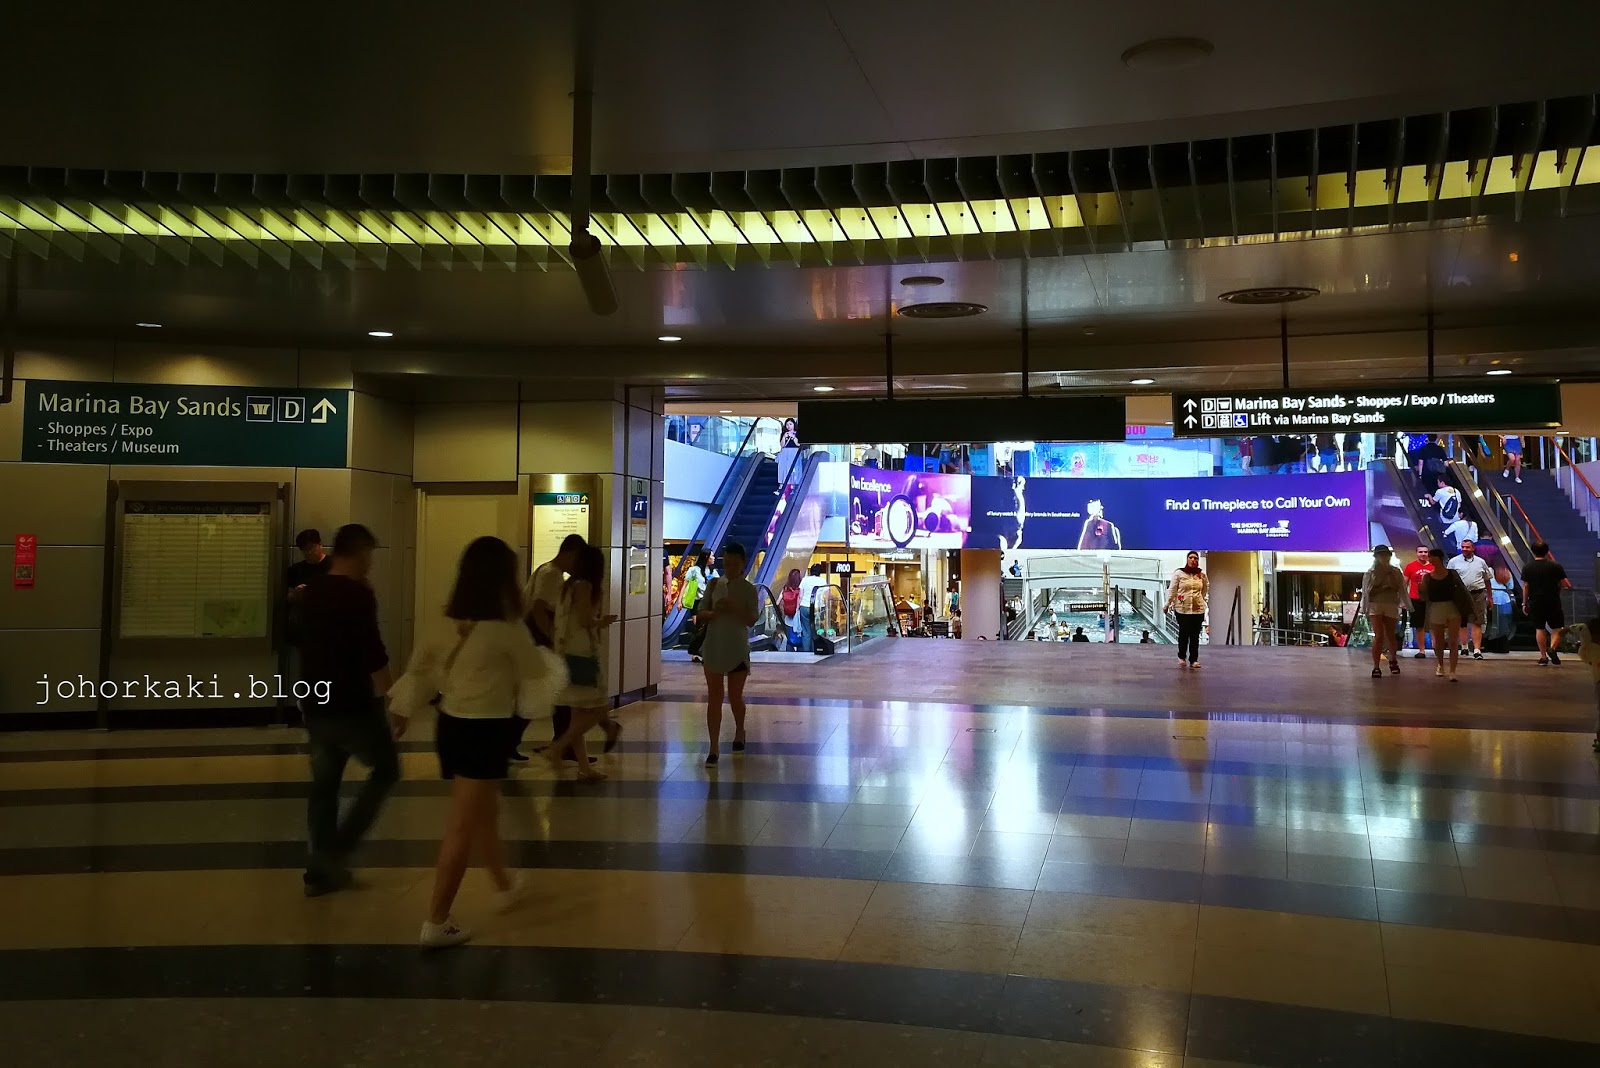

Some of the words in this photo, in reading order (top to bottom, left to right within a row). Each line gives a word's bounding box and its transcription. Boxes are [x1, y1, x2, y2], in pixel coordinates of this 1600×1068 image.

[39, 392, 120, 415] Marina
[130, 395, 170, 419] Bay
[177, 396, 242, 418] Sands
[284, 400, 300, 419] D
[1234, 397, 1279, 410] Marina
[1282, 396, 1306, 411] Bay
[1308, 394, 1346, 408] Sands
[1356, 395, 1402, 408] Shoppes
[1411, 394, 1438, 407] Expo
[1446, 393, 1496, 405] Theaters
[1251, 412, 1272, 426] Lift
[1273, 414, 1290, 426] via
[1292, 413, 1329, 425] Marina
[1331, 413, 1352, 426] Bay
[1353, 411, 1386, 423] Sands
[48, 421, 107, 438] Shoppes
[121, 423, 153, 438] Expo
[47, 439, 108, 453] Theaters
[122, 441, 180, 454] Museum
[1165, 498, 1190, 512] Find
[1192, 501, 1200, 511] a
[1202, 497, 1259, 513] Timepiece
[1261, 499, 1274, 510] to
[1275, 496, 1298, 510] Call
[1298, 495, 1323, 509] Your
[1325, 495, 1351, 508] Own
